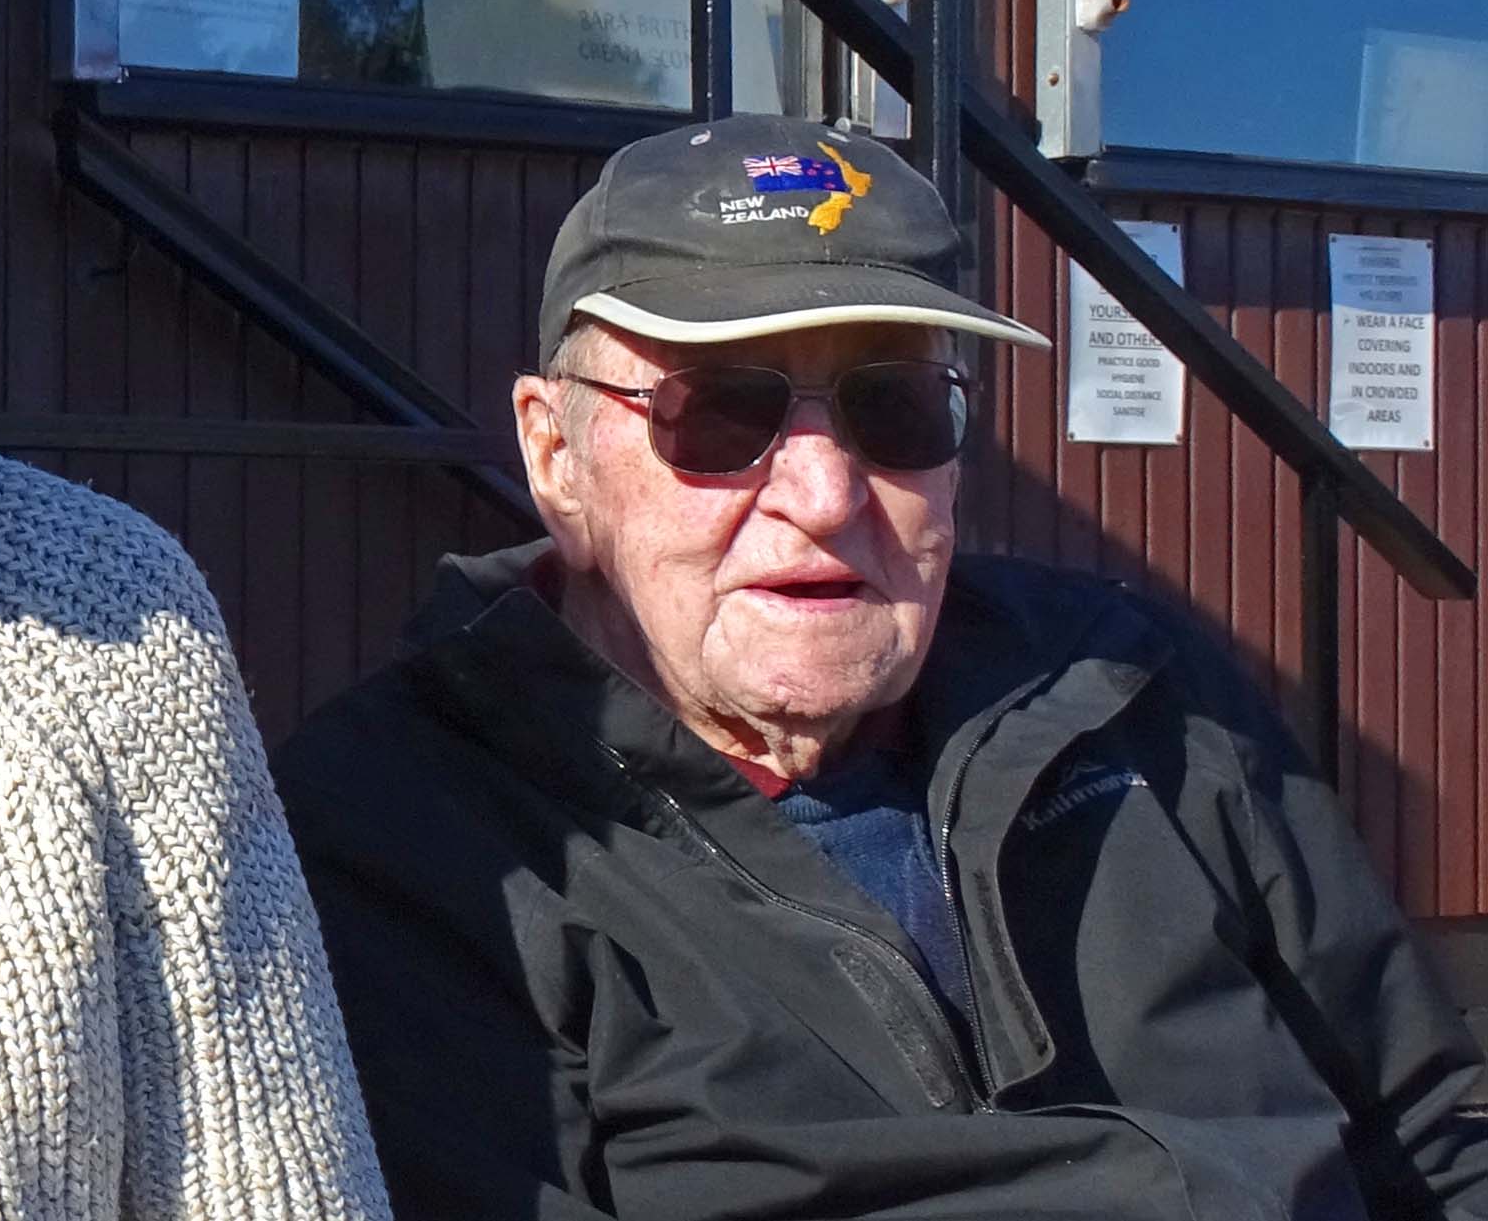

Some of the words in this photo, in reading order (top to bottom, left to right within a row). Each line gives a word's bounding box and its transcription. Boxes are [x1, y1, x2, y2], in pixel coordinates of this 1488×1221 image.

[720, 195, 766, 213] NEW
[721, 204, 810, 225] ZEALAND
[1356, 315, 1386, 328] WEAR
[1388, 315, 1397, 328] A
[1399, 316, 1426, 330] FACE
[1089, 331, 1114, 346] AND
[1357, 339, 1411, 353] COVERING
[1348, 362, 1396, 376] INDOORS
[1398, 363, 1421, 377] AND
[1351, 386, 1363, 398] IN
[1365, 386, 1419, 400] CROWDED
[1367, 409, 1402, 423] AREAS
